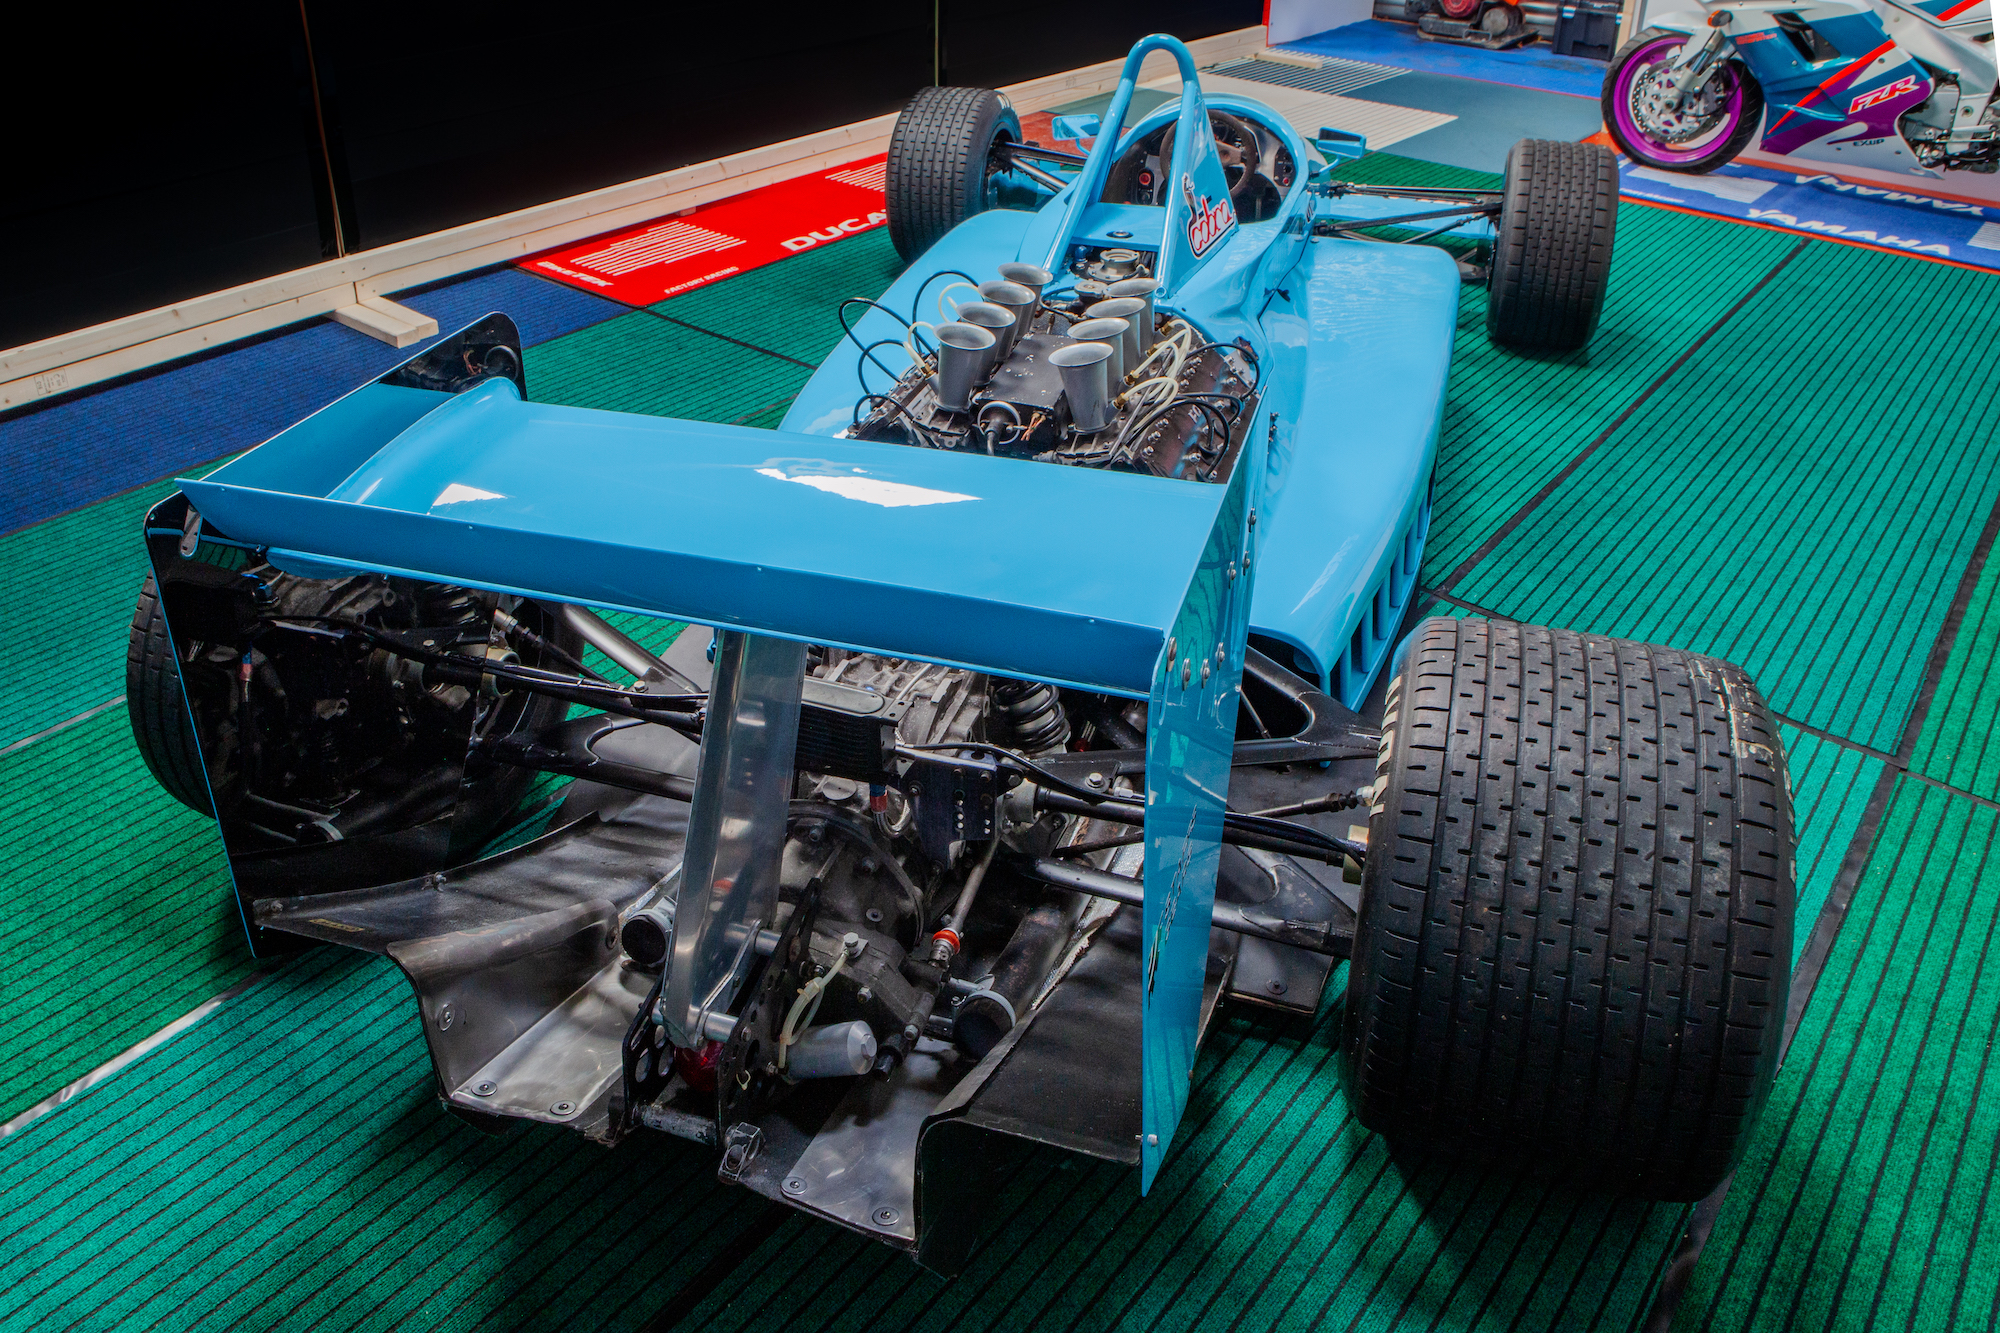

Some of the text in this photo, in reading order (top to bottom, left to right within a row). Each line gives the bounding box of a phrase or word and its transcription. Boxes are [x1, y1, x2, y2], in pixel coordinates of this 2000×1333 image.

[1848, 75, 1920, 115] FZR
[1796, 174, 1984, 216] YAMAHA
[780, 209, 887, 251] DUCA
[1191, 196, 1233, 251] cobra
[1746, 208, 1950, 256] YAMAHA
[663, 266, 740, 294] FACTORY RACING
